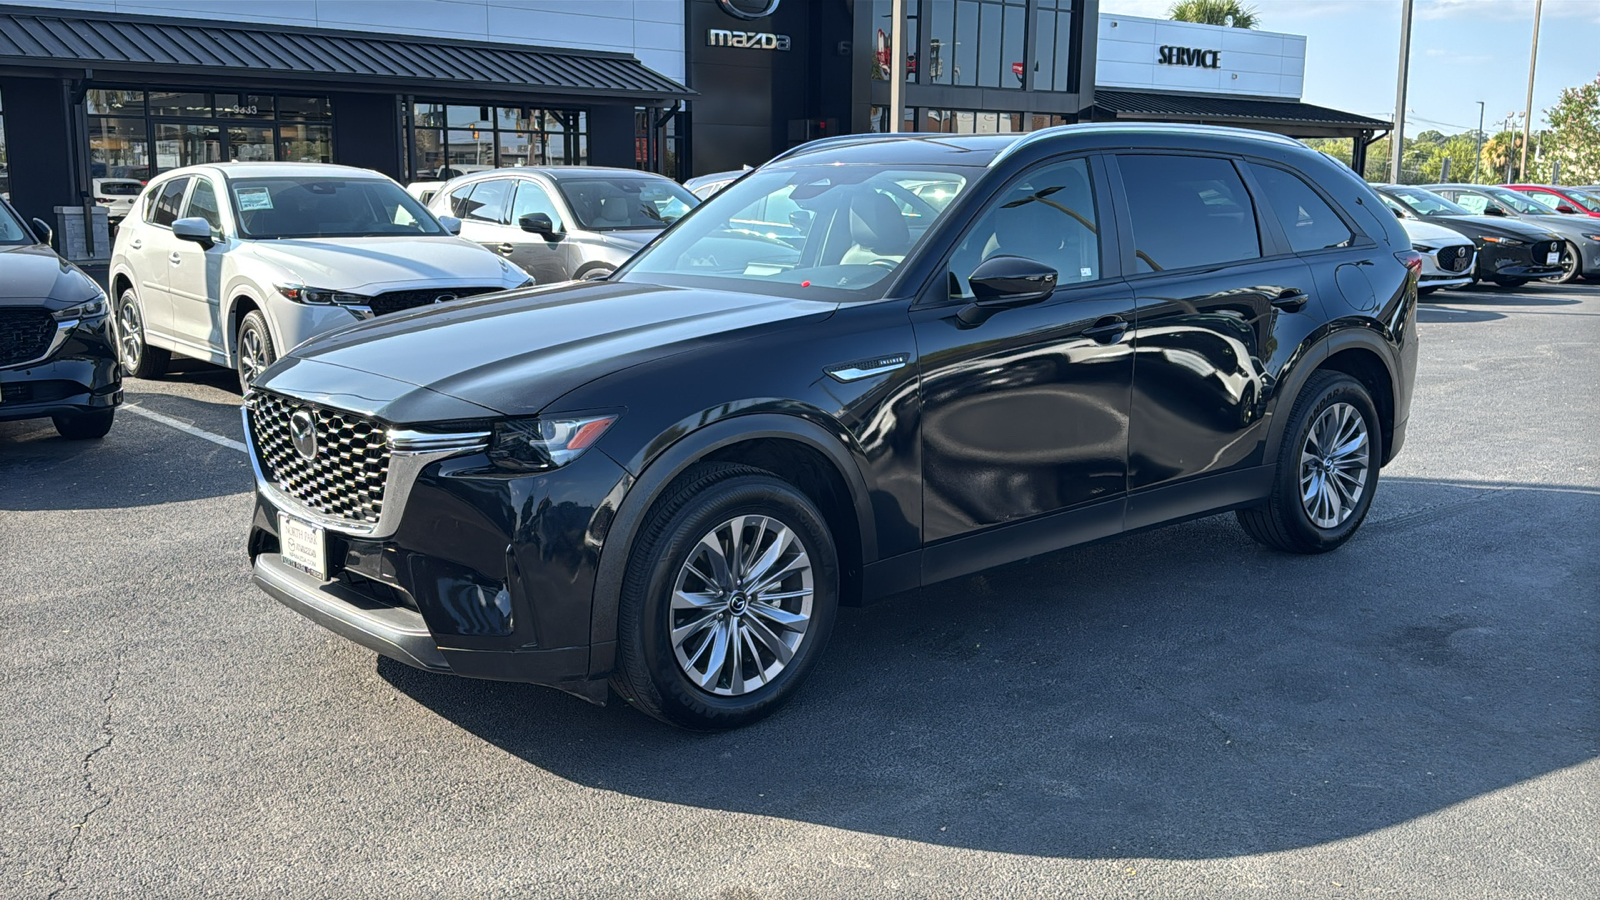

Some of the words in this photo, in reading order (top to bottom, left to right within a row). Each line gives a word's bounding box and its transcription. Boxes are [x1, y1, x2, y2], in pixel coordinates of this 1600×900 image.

[708, 29, 791, 51] mazda
[1158, 45, 1222, 69] SERVICE
[285, 525, 303, 539] NORTH
[304, 531, 317, 545] PARK
